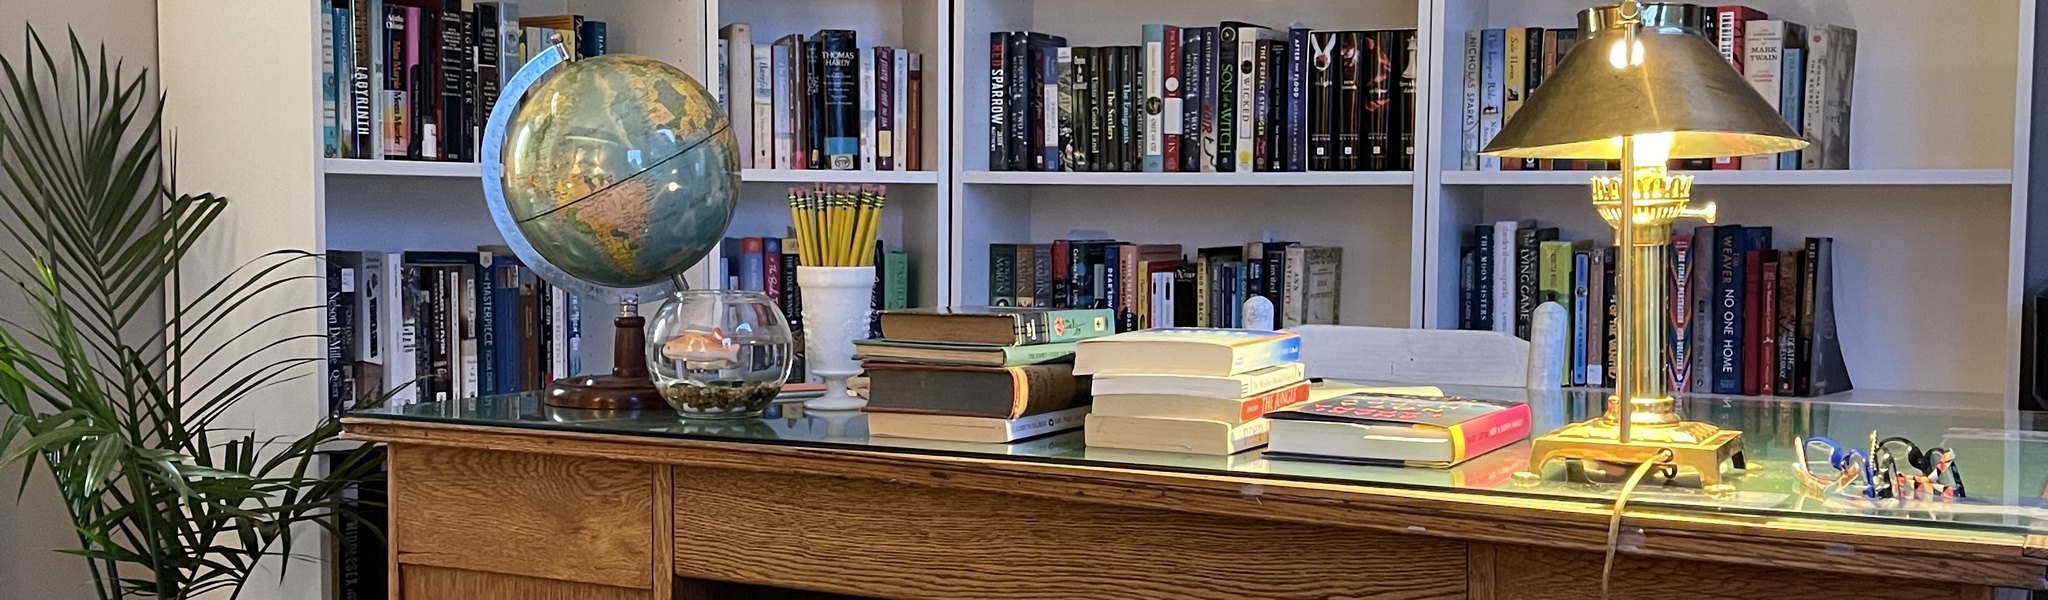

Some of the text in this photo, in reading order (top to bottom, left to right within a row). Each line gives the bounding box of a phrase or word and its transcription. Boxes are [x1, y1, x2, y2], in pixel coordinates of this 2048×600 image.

[1488, 34, 1498, 51] The
[1721, 14, 1732, 42] INGRID
[464, 22, 473, 106] NIGHT TIGER
[822, 51, 855, 60] THOMAS
[825, 58, 851, 67] HARDY
[1205, 31, 1213, 75] CHRISTOPHER
[1750, 53, 1778, 61] TWAIN
[991, 44, 1004, 126] RED SPARROW
[1017, 55, 1025, 93] JACQUELYN
[1091, 76, 1099, 98] Unto
[1191, 52, 1199, 93] JACQUELYN
[1220, 63, 1233, 94] SON
[1258, 45, 1267, 136] THE PERFECT STRANGER
[1466, 37, 1478, 126] NICHOLAS SPARKS
[1488, 81, 1498, 101] Ride
[357, 66, 370, 136] LABYRINTH
[391, 40, 404, 146] Miss Marple Meets Murder
[1242, 77, 1250, 123] WICKED
[1017, 109, 1025, 130] TWO
[1091, 106, 1099, 131] Good
[1107, 89, 1116, 140] The Settlers
[1121, 82, 1132, 144] The Emigrants
[1190, 110, 1199, 131] TWO
[1220, 108, 1233, 154] WITCH
[1091, 132, 1099, 154] Land
[1184, 124, 1192, 140] SEA
[995, 256, 1004, 294] MARTIN
[1018, 256, 1027, 293] MARTIN
[1035, 257, 1045, 296] MARTIN
[1465, 252, 1473, 265] THE
[1520, 248, 1531, 284] LYING
[1676, 263, 1686, 286] FEMALE
[1722, 235, 1733, 284] WEAVER
[1733, 252, 1741, 268] TIM
[785, 256, 794, 318] THE FOUR WINDS
[1198, 288, 1205, 300] ME
[1285, 257, 1294, 306] PATCHETT
[1480, 235, 1488, 321] THE MOON SISTERS
[483, 281, 494, 347] MASTERPIECE
[1520, 285, 1531, 321] GAME
[1676, 287, 1686, 324] PERSUASION
[329, 291, 341, 365] Nelson DeMille
[1607, 304, 1618, 378] OF THE VANITIES
[1723, 289, 1735, 374] NO ONE HOME
[1676, 341, 1685, 371] WOLITZER
[1786, 338, 1796, 359] DEATH
[330, 369, 341, 400] QUEST
[1261, 393, 1275, 414] THE
[1273, 386, 1299, 410] JUNGLE
